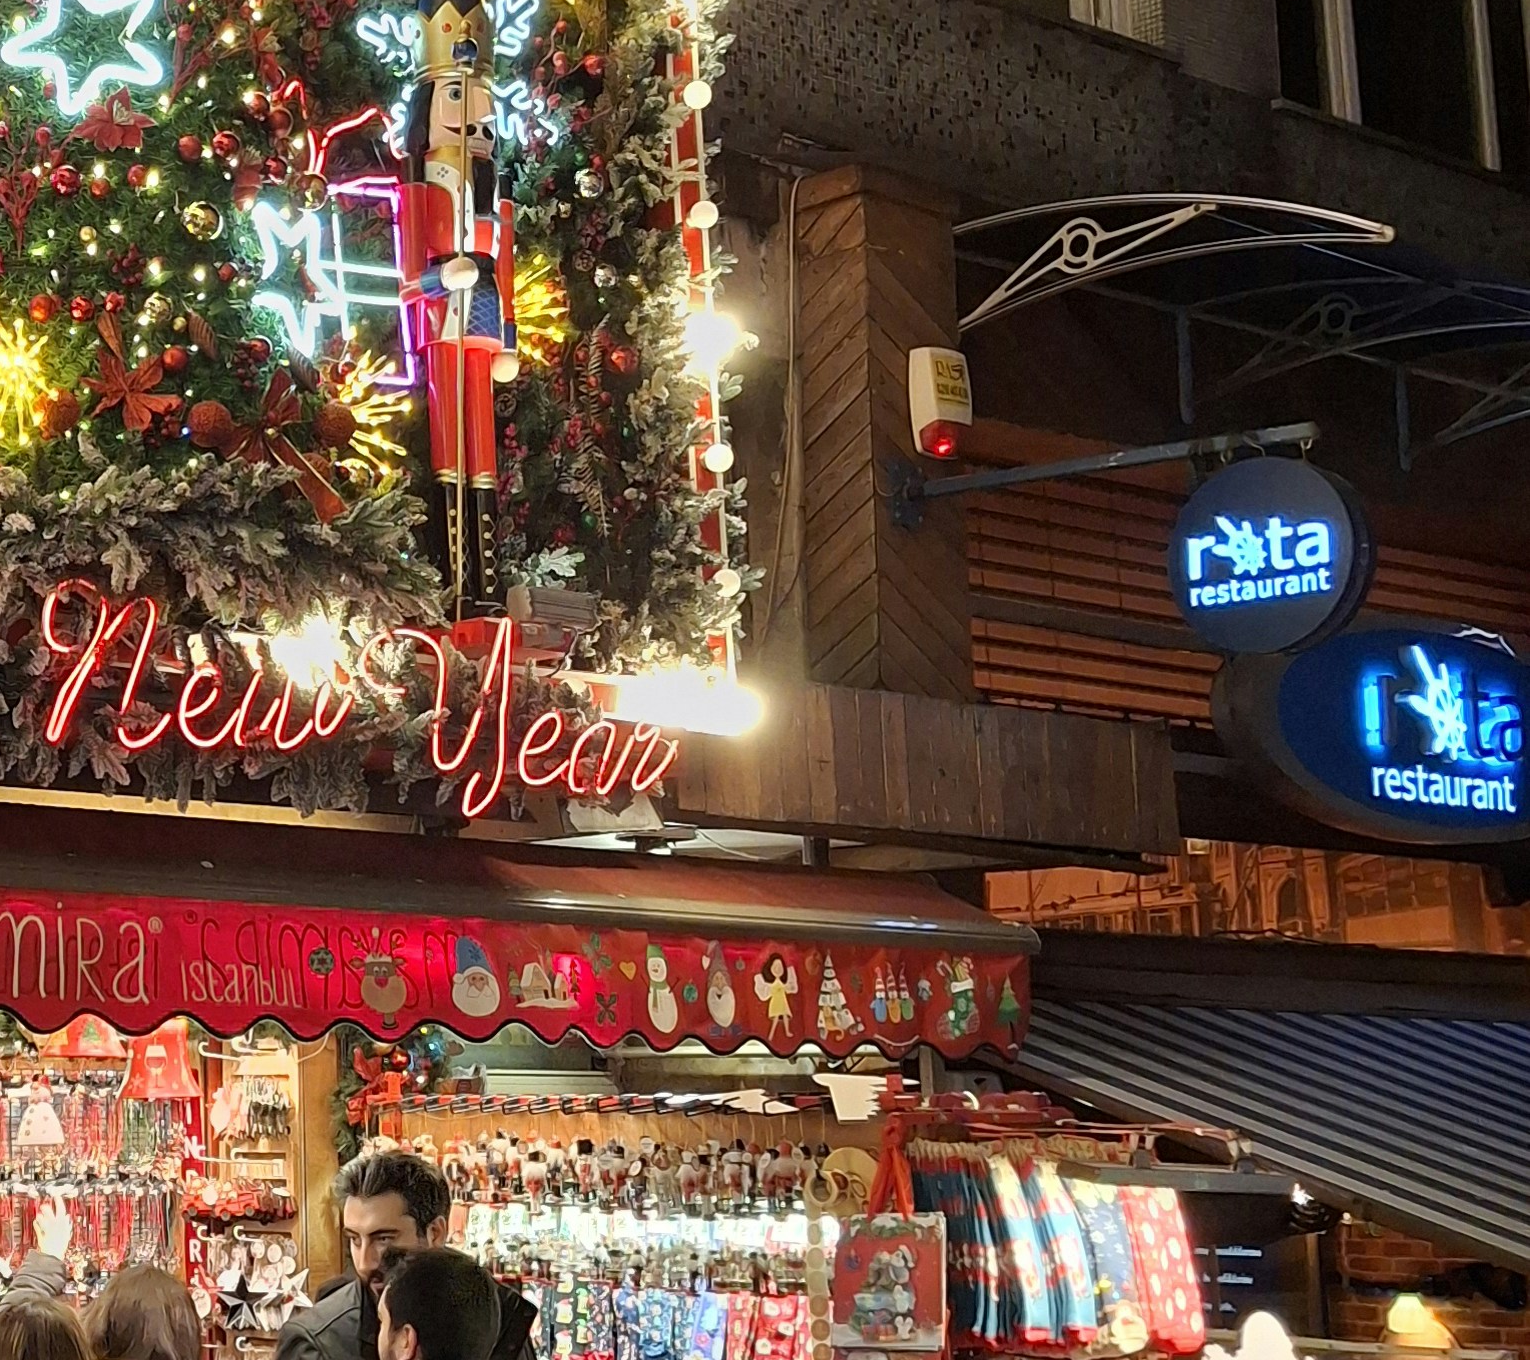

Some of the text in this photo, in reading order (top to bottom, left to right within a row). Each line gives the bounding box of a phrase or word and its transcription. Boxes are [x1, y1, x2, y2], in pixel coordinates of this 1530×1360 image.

[1189, 567, 1333, 607] restaurant
[43, 578, 358, 750] New
[363, 615, 678, 818] Year
[1372, 763, 1517, 814] restaurant
